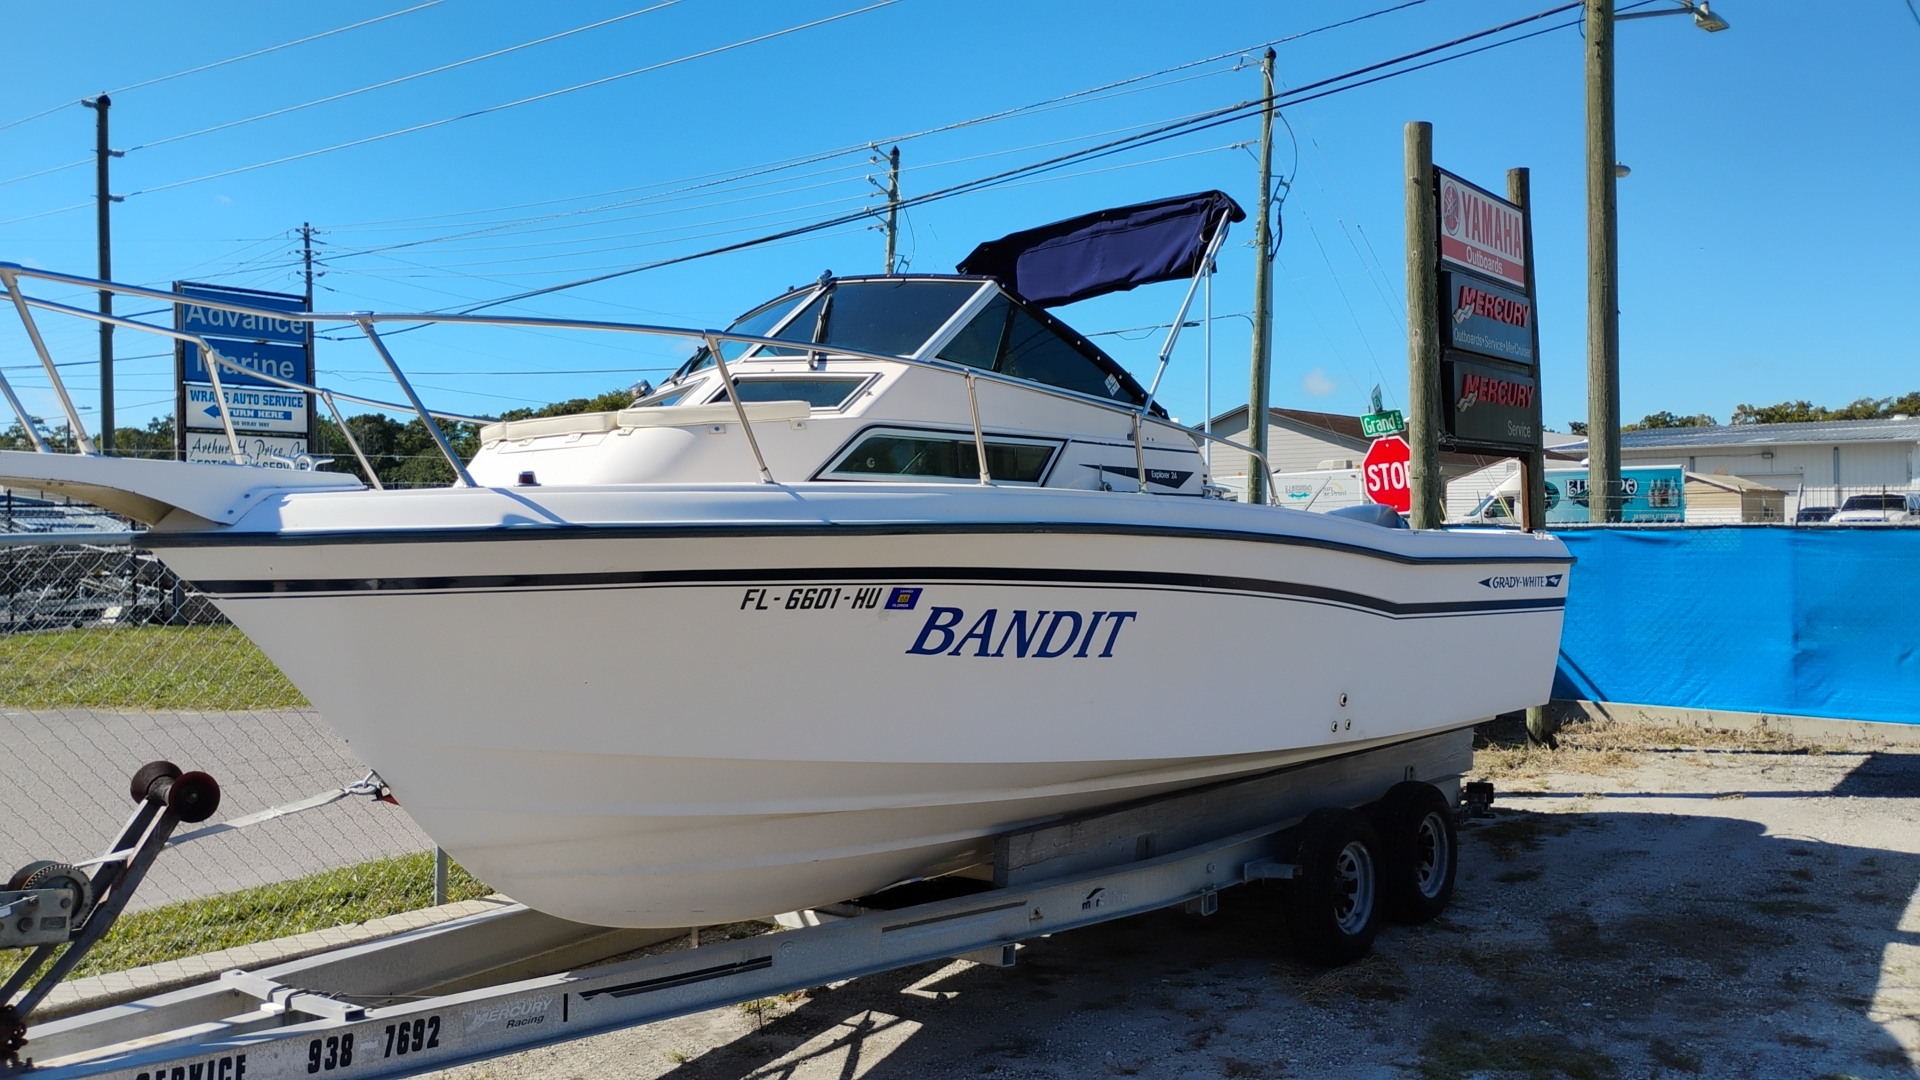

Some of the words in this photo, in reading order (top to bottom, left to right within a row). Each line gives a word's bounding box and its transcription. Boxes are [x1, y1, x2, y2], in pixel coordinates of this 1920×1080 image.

[1462, 191, 1522, 260] YAMAHA
[1466, 246, 1503, 275] Outboards
[186, 305, 304, 335] Advance
[1459, 285, 1531, 328] MERCURY
[190, 390, 229, 404] WRAS
[233, 393, 260, 405] AUTO
[263, 395, 304, 408] SERVICE
[1462, 374, 1534, 409] MERCURY
[228, 408, 254, 417] TURN
[257, 411, 284, 419] HERE
[1364, 414, 1396, 433] Grand
[1507, 420, 1531, 438] Service
[1151, 470, 1170, 480] Explorer
[1367, 460, 1411, 492] STOP
[1492, 575, 1544, 588] GRADY-WHITE
[905, 606, 1137, 658] BANDIT
[470, 998, 554, 1025] MERCURY
[506, 1014, 545, 1029] Racing
[308, 1033, 354, 1074] 938
[384, 1015, 441, 1058] 7692
[136, 1055, 246, 1080] RVICE
